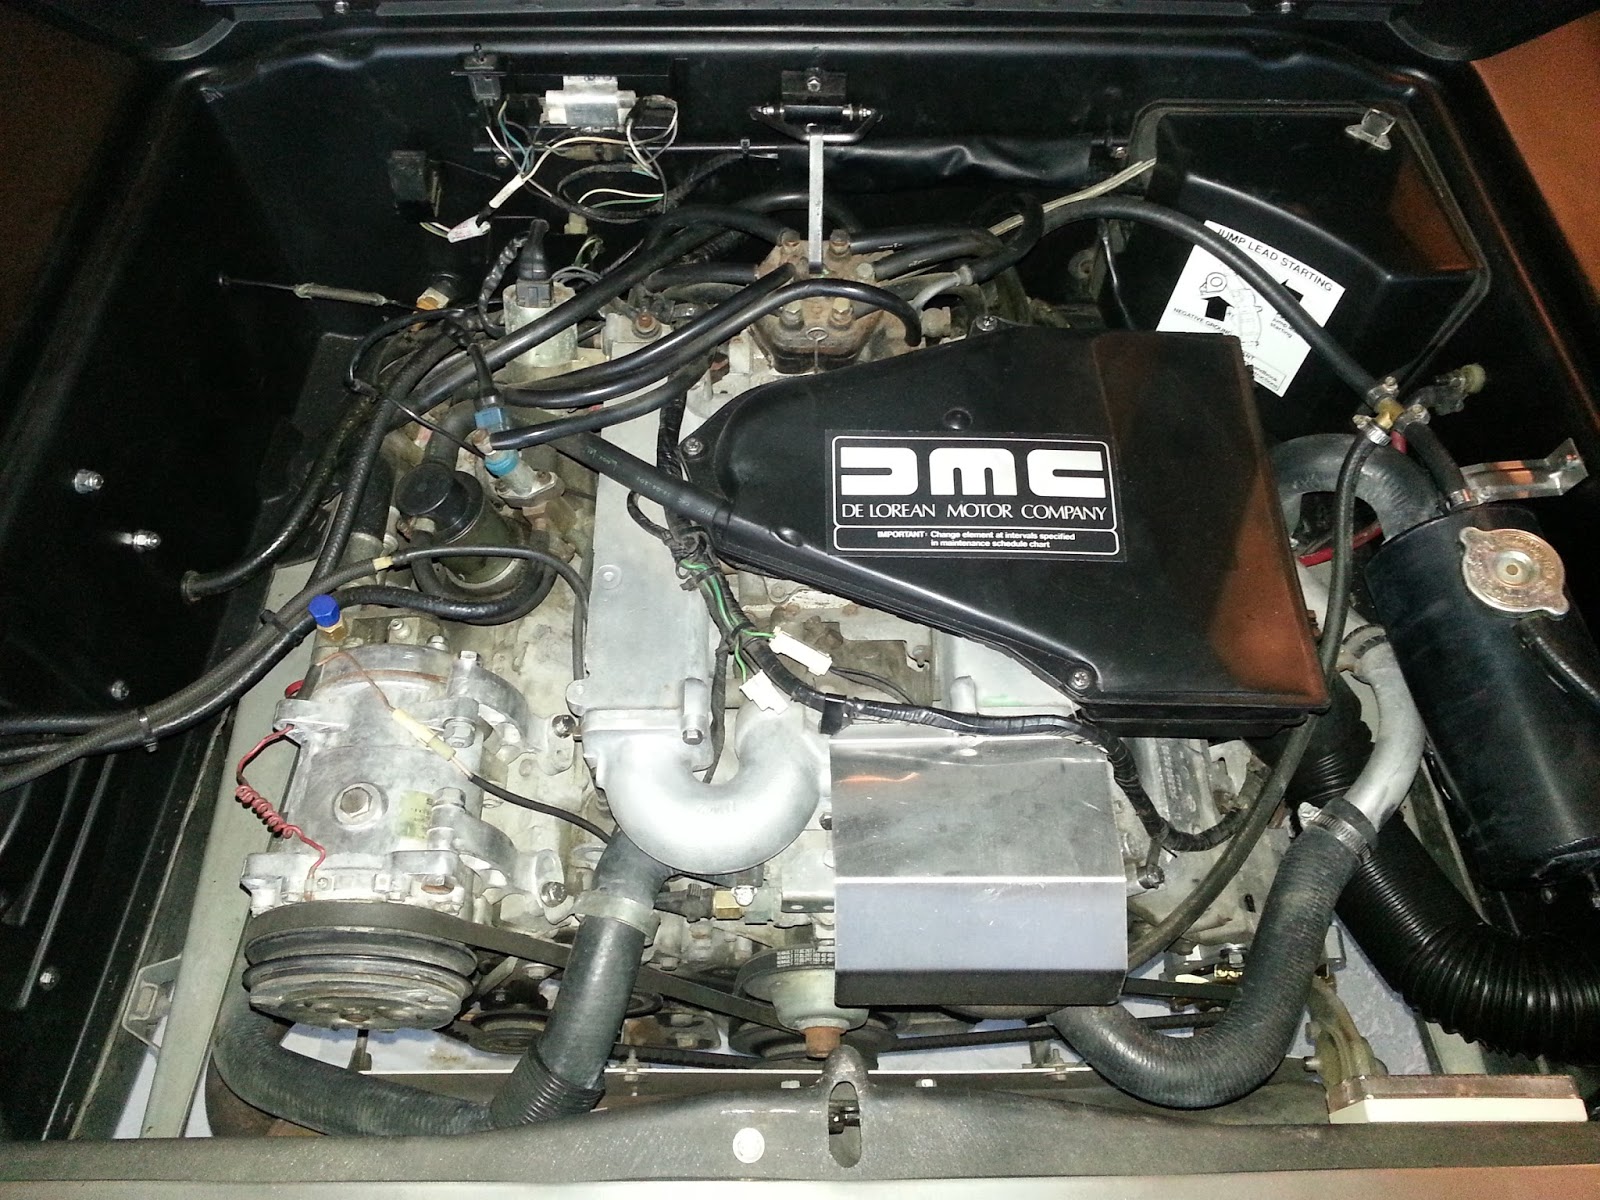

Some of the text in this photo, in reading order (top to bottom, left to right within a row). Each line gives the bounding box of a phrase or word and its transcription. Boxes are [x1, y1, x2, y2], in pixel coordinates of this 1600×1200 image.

[1218, 228, 1333, 292] JUMP LEAD STARTING
[1173, 306, 1205, 323] NEGATIVE
[841, 503, 1107, 521] DE LOREAN MOTOR COMPANY
[930, 530, 961, 541] Change
[962, 531, 994, 539] element
[995, 531, 1004, 540] at
[1005, 531, 1038, 541] intervals
[1039, 532, 1076, 542] specified
[931, 539, 1051, 549] in maintenance schedule chart
